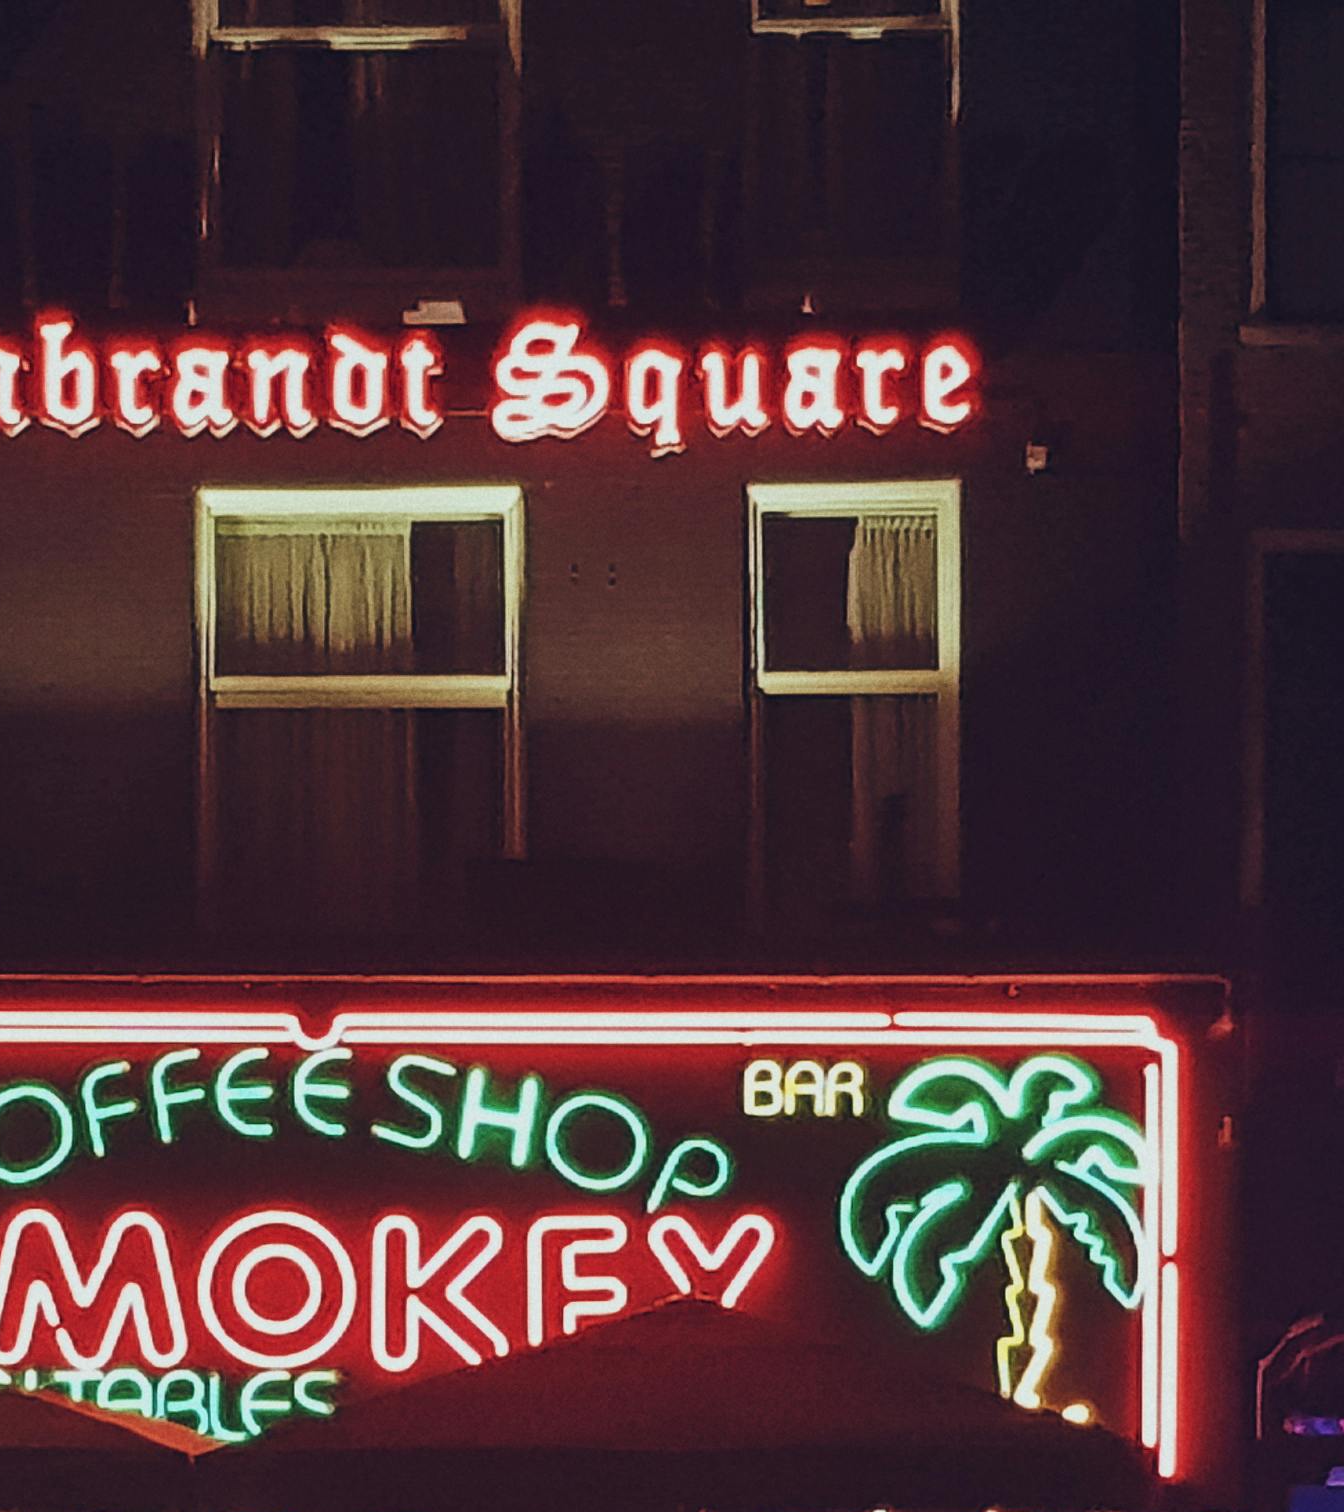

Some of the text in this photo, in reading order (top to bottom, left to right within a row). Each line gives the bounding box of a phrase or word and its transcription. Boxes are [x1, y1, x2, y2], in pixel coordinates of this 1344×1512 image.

[494, 320, 978, 456] Square
[372, 1055, 731, 1211] SHOP
[743, 1061, 863, 1118] BAR
